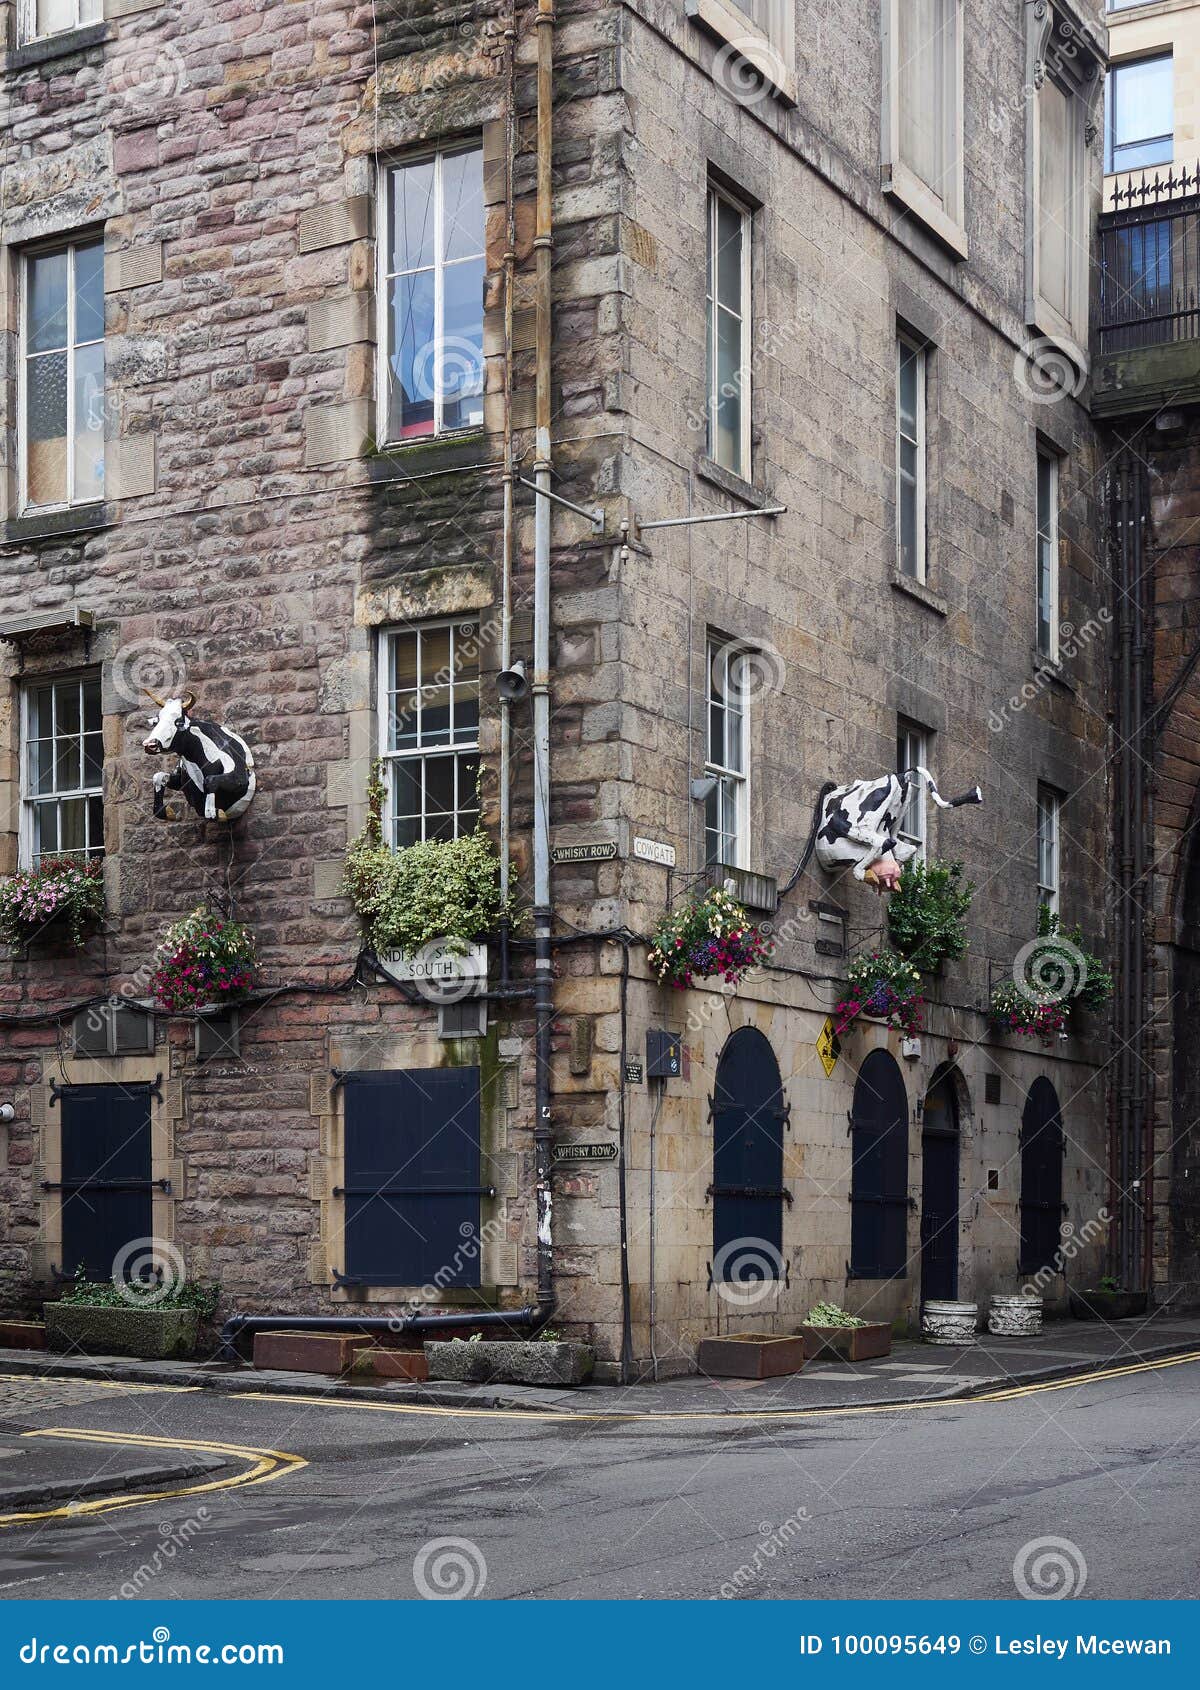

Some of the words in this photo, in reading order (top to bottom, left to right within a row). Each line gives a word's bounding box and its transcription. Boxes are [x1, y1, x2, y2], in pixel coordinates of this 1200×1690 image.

[557, 848, 589, 859] WHISKY
[591, 845, 610, 857] ROW
[635, 841, 674, 863] COWGATE
[409, 961, 453, 977] SOUTH
[557, 1146, 589, 1157] WHISKY
[591, 1145, 611, 1156] ROW
